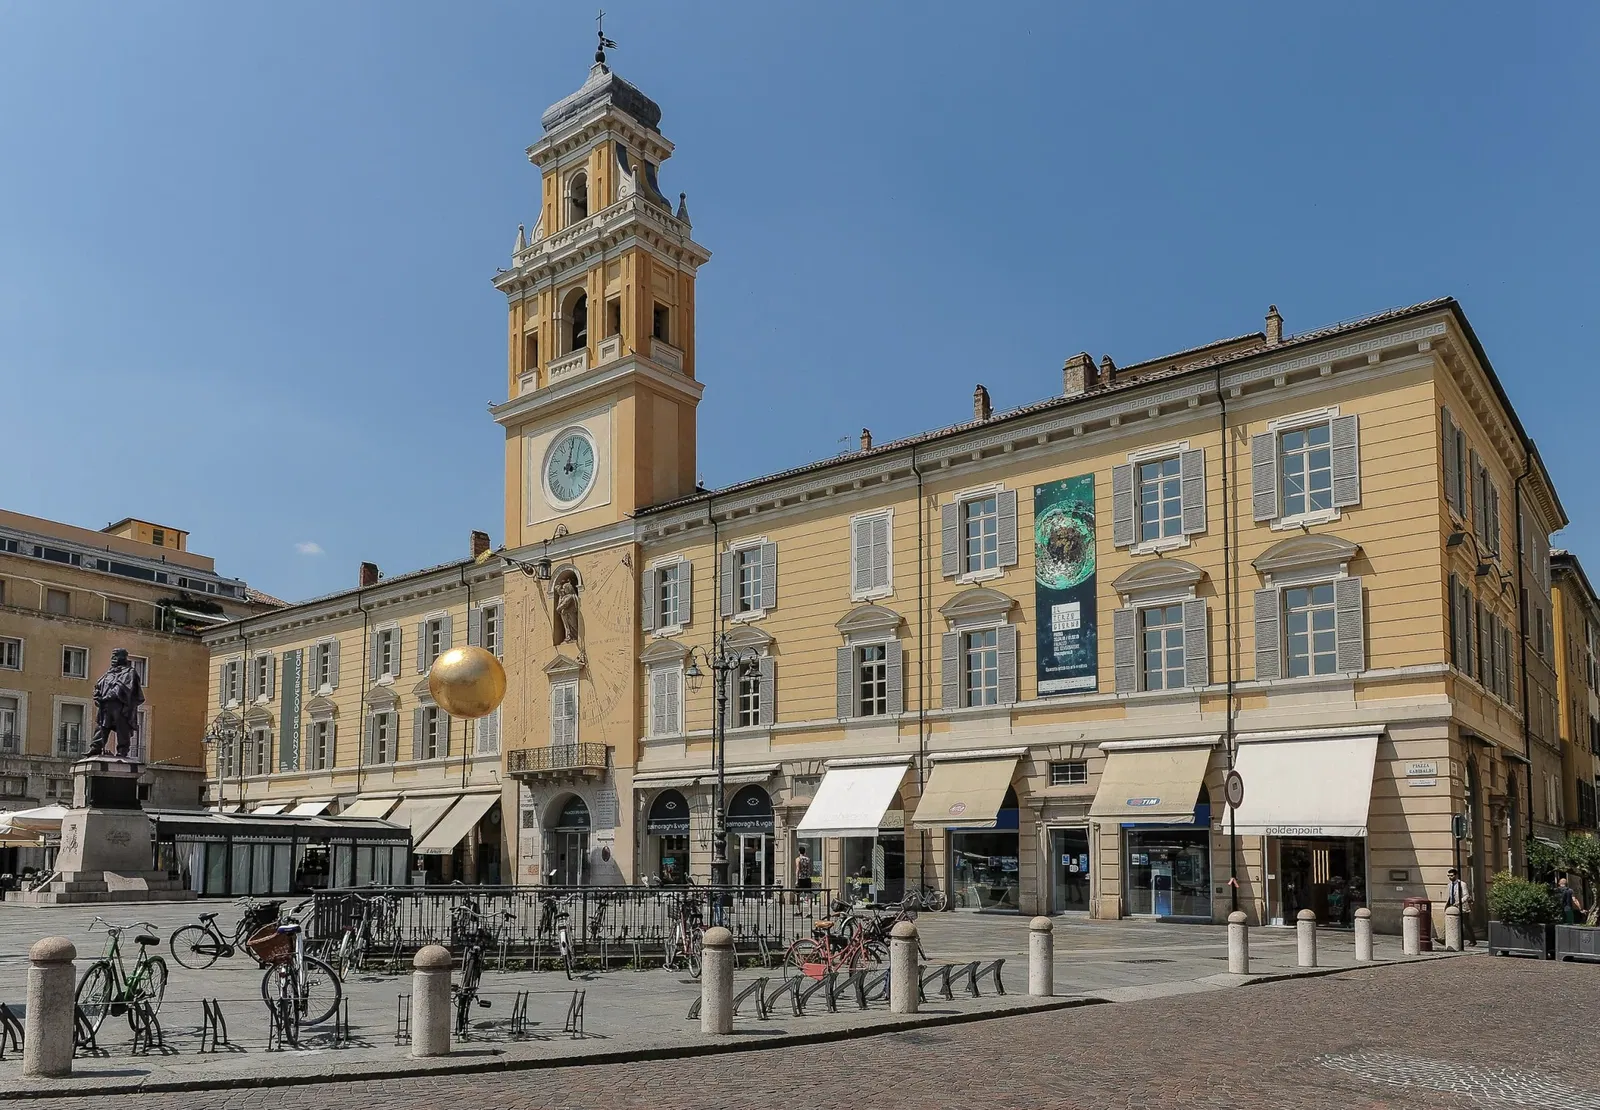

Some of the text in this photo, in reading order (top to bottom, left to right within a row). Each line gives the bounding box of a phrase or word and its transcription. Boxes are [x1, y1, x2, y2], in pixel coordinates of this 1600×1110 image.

[1053, 612, 1075, 622] TERZO
[1053, 620, 1079, 630] GIORNO
[292, 731, 300, 769] PALAZZO
[1265, 826, 1324, 836] goldenpoint
